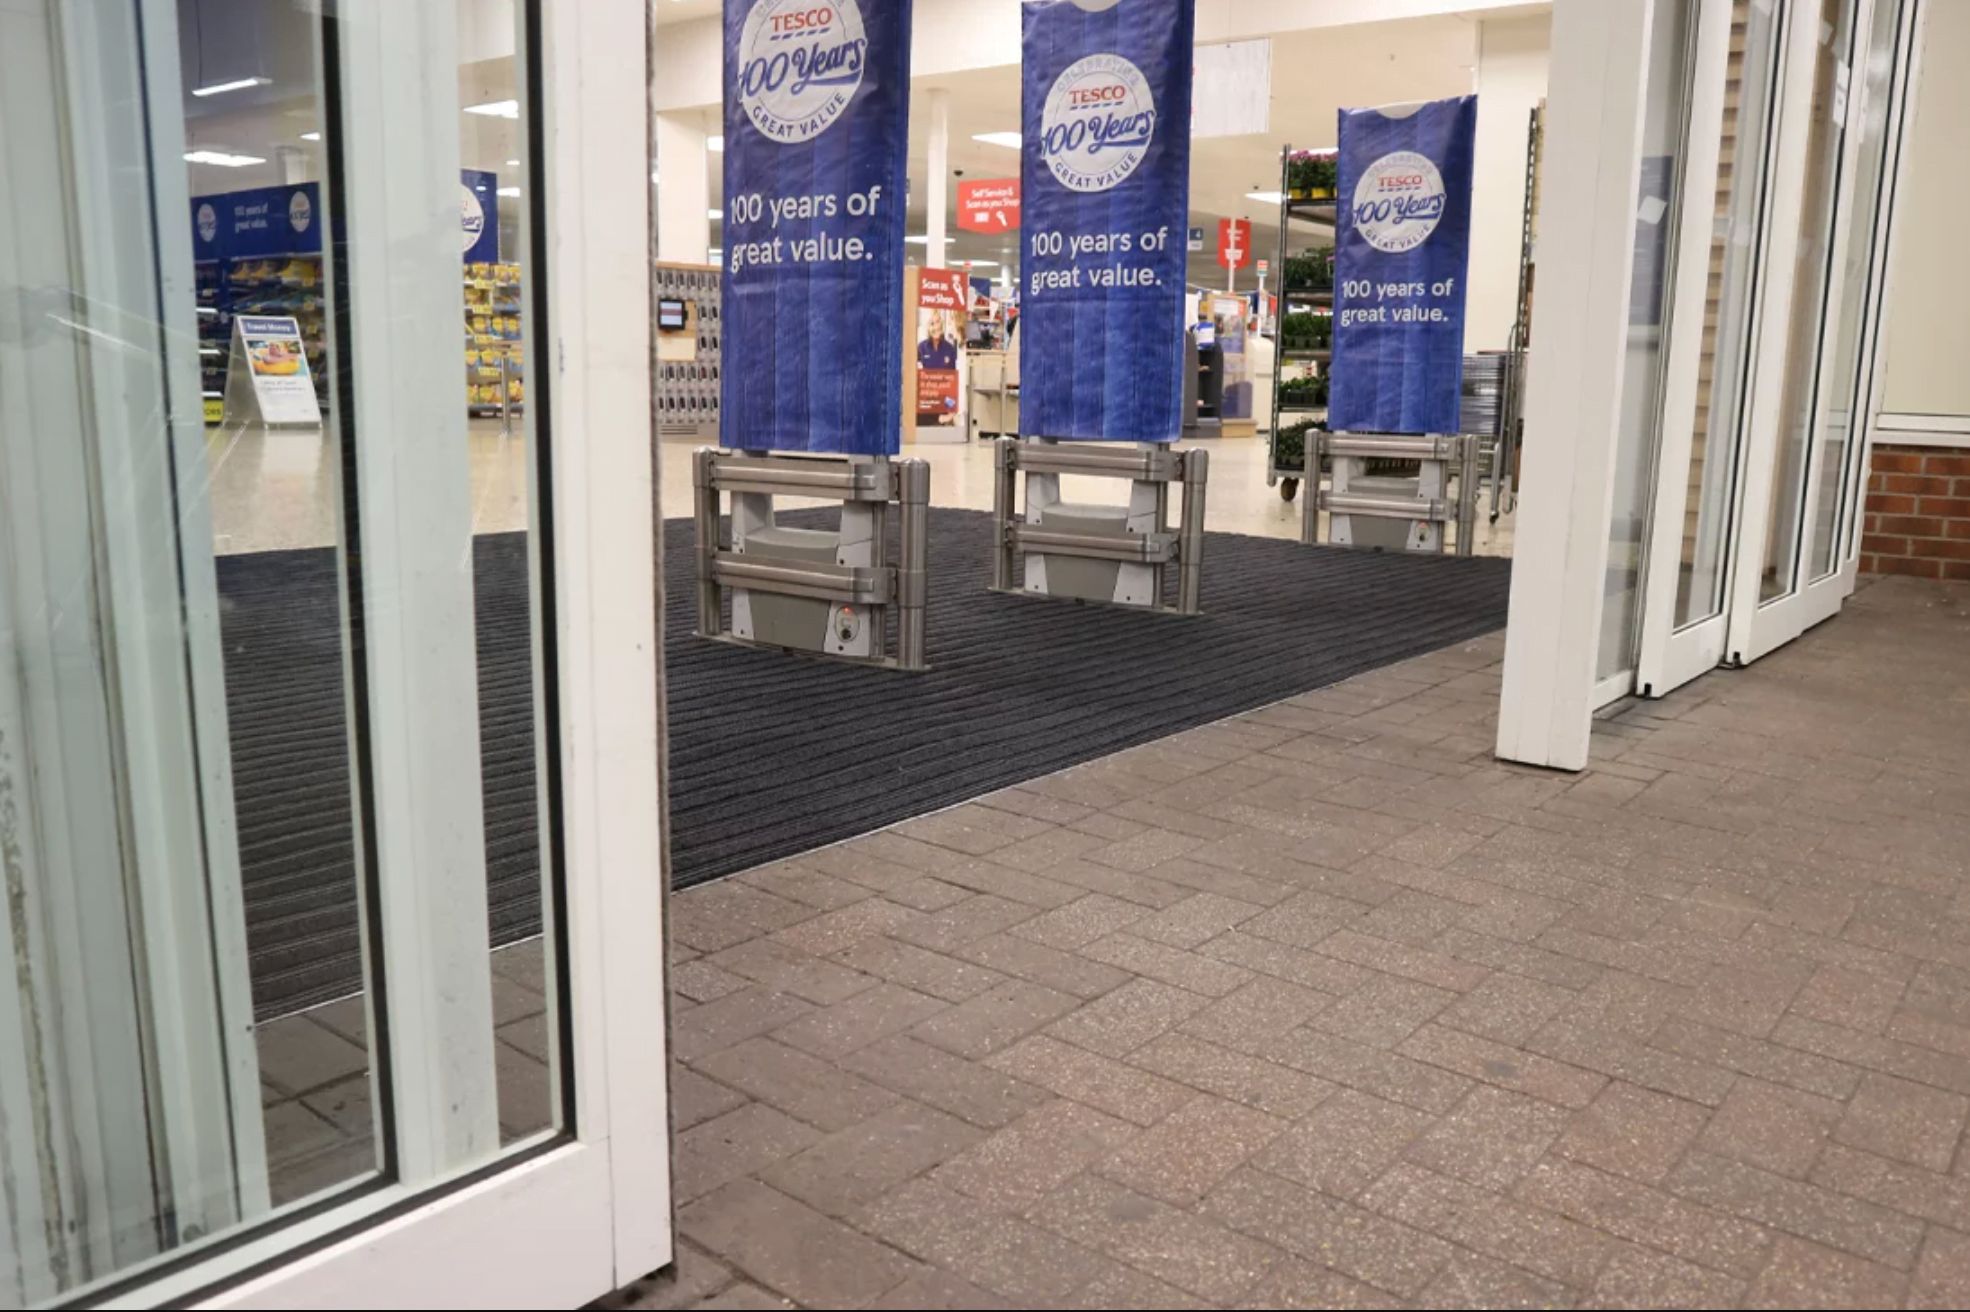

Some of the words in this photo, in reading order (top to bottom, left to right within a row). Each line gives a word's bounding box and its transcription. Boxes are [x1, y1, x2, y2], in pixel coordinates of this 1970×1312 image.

[770, 8, 833, 32] TESCO
[738, 52, 790, 101] 100
[791, 38, 867, 95] Years
[1069, 85, 1126, 104] TESCO
[753, 106, 794, 138] GREAT
[800, 92, 845, 135] VALUE
[1041, 119, 1086, 156] 100
[1088, 110, 1155, 155] Years
[1055, 162, 1091, 187] GREAT
[1096, 152, 1138, 187] VALUE
[1378, 175, 1422, 187] TESCO
[730, 193, 763, 225] 100
[769, 193, 838, 229] years
[846, 185, 882, 216] of
[1352, 198, 1391, 226] 100
[1392, 193, 1447, 225] Years
[731, 236, 783, 274] great
[790, 231, 873, 263] value.
[1031, 231, 1062, 257] 100
[1069, 232, 1132, 260] years
[1140, 225, 1168, 252] of
[1365, 229, 1395, 249] GREAT
[1400, 223, 1430, 248] VALUE
[922, 278, 940, 289] Scan
[940, 282, 949, 291] as
[1030, 265, 1081, 296] great
[1088, 262, 1162, 287] value.
[1341, 280, 1371, 299] 100
[1376, 282, 1426, 302] years
[1431, 278, 1454, 297] of
[921, 294, 936, 305] you
[936, 293, 954, 307] Shop
[1340, 305, 1387, 327] great
[1392, 304, 1449, 323] value.
